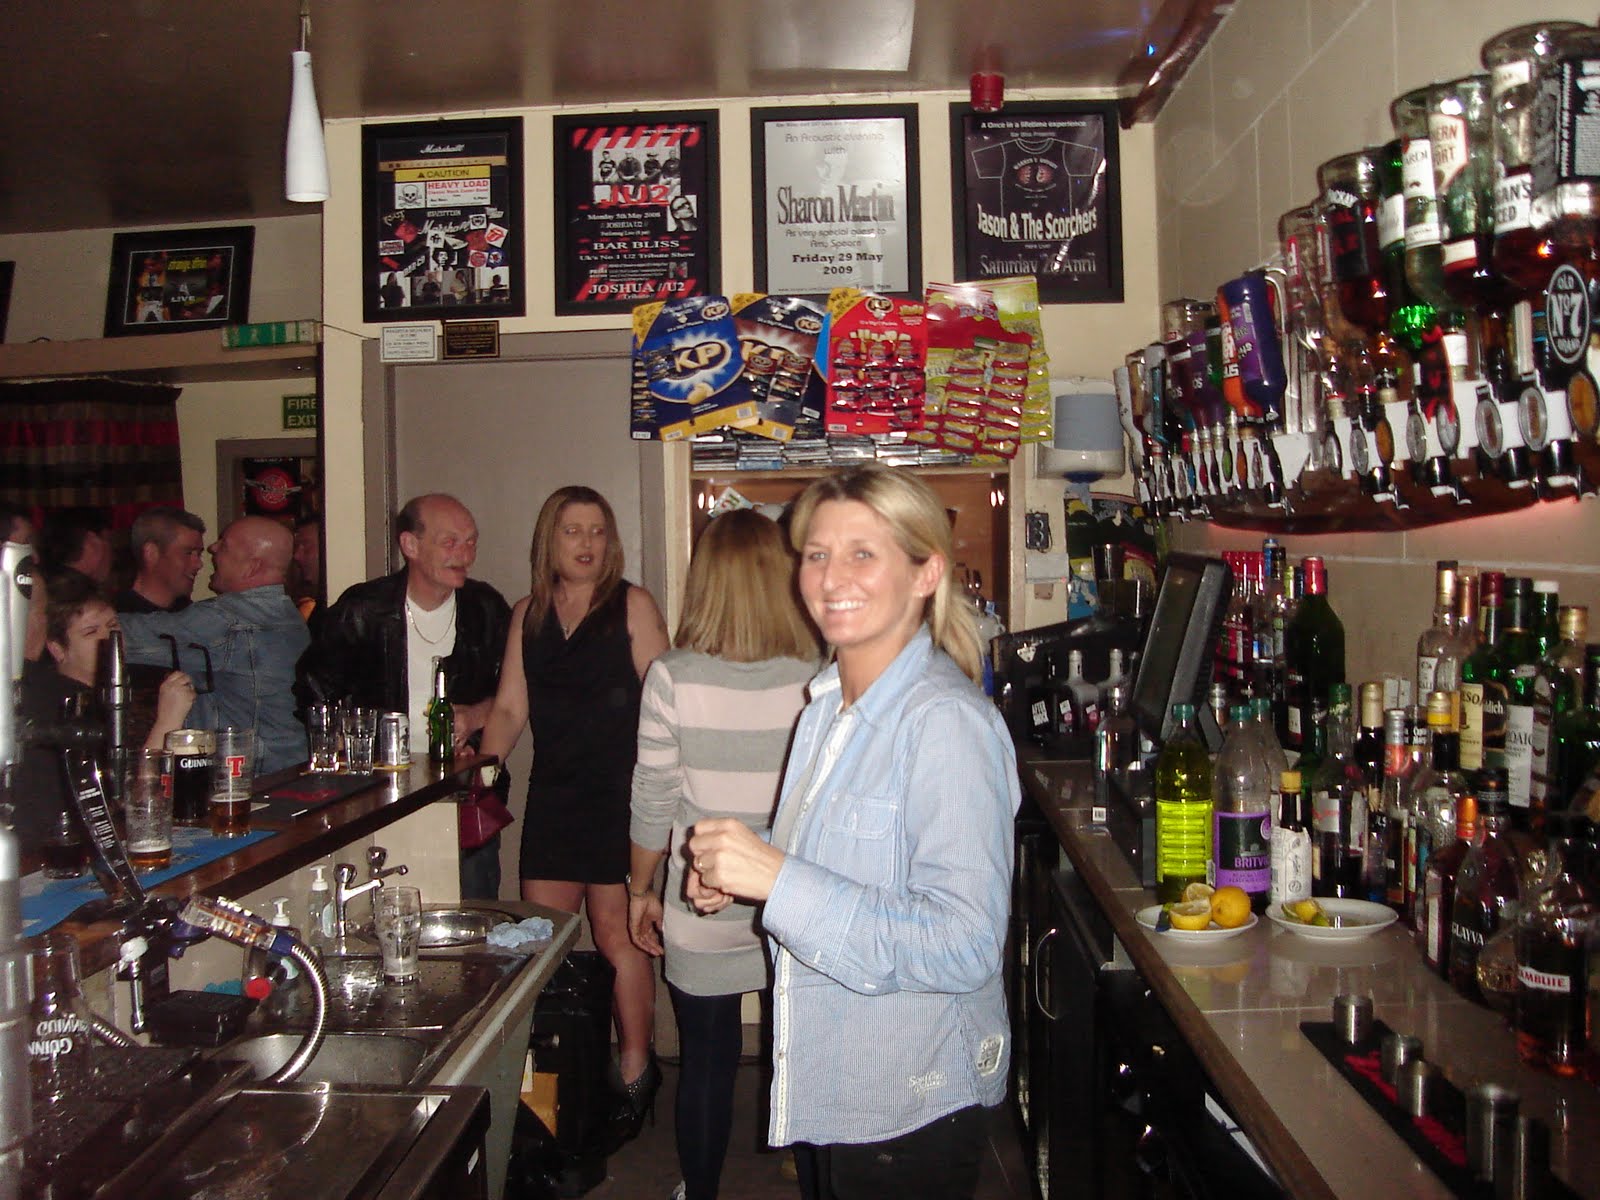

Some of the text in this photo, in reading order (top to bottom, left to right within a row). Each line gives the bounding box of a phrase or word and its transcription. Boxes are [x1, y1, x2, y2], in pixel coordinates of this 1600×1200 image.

[987, 121, 1006, 129] Once
[1020, 120, 1048, 128] lifetime
[1048, 120, 1087, 129] experience
[785, 133, 885, 143] An Acoustic evening
[420, 144, 465, 154] Marshall
[824, 147, 846, 155] with
[426, 169, 470, 179] CAUTION
[427, 180, 489, 190] HEAVY LOAD
[777, 183, 896, 225] Sharon Martin
[977, 203, 1098, 240] Jason & The Scorchers
[785, 229, 796, 237] As
[798, 230, 817, 238] very
[819, 228, 849, 238] special
[850, 228, 875, 237] guest
[593, 240, 680, 250] BAR BLISS
[792, 252, 883, 264] Friday 29 May
[823, 266, 853, 275] 2009
[1557, 273, 1575, 290] OLD
[588, 283, 655, 295] JOSHUA
[170, 295, 196, 303] LIVE
[870, 298, 890, 310] KP
[705, 303, 728, 318] KP
[800, 319, 820, 330] KP
[674, 342, 722, 372] KP
[287, 398, 317, 409] FIRE
[287, 414, 317, 426] EXIT
[180, 757, 213, 769] GUINN
[226, 755, 245, 778] T
[1234, 856, 1269, 869] BRITVI
[1520, 970, 1565, 988] AMBUIE
[27, 1037, 73, 1057] GUINN
